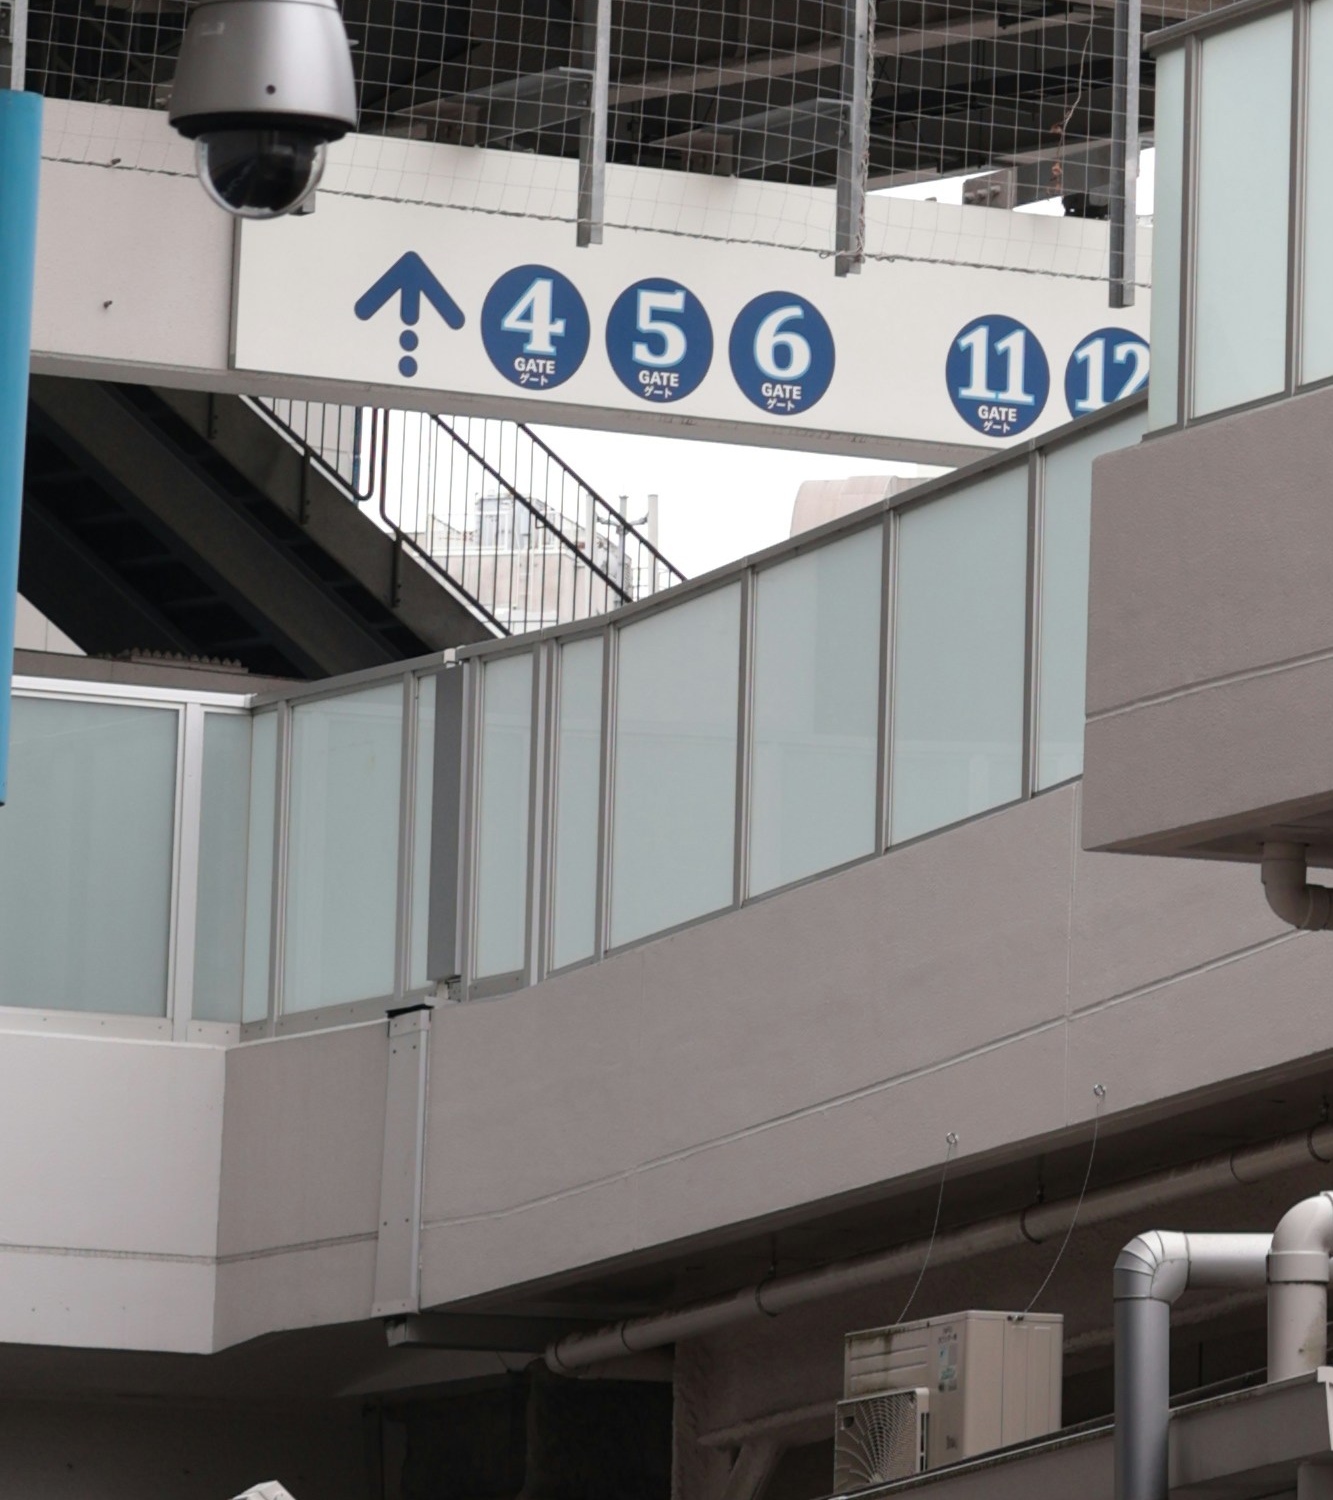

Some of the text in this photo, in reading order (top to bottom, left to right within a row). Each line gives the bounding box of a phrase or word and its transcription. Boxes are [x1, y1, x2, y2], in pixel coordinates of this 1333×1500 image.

[500, 277, 566, 356] 4
[632, 287, 687, 368] 5
[753, 305, 812, 381] 6
[514, 357, 556, 375] GATE
[956, 324, 1035, 406] 11
[519, 373, 549, 387] ゲート
[638, 370, 680, 388] GATE
[643, 386, 673, 399] ゲート
[761, 383, 802, 401] GATE
[766, 398, 796, 412] ゲート
[977, 405, 1018, 423] GATE
[982, 420, 1011, 434] ゲート
